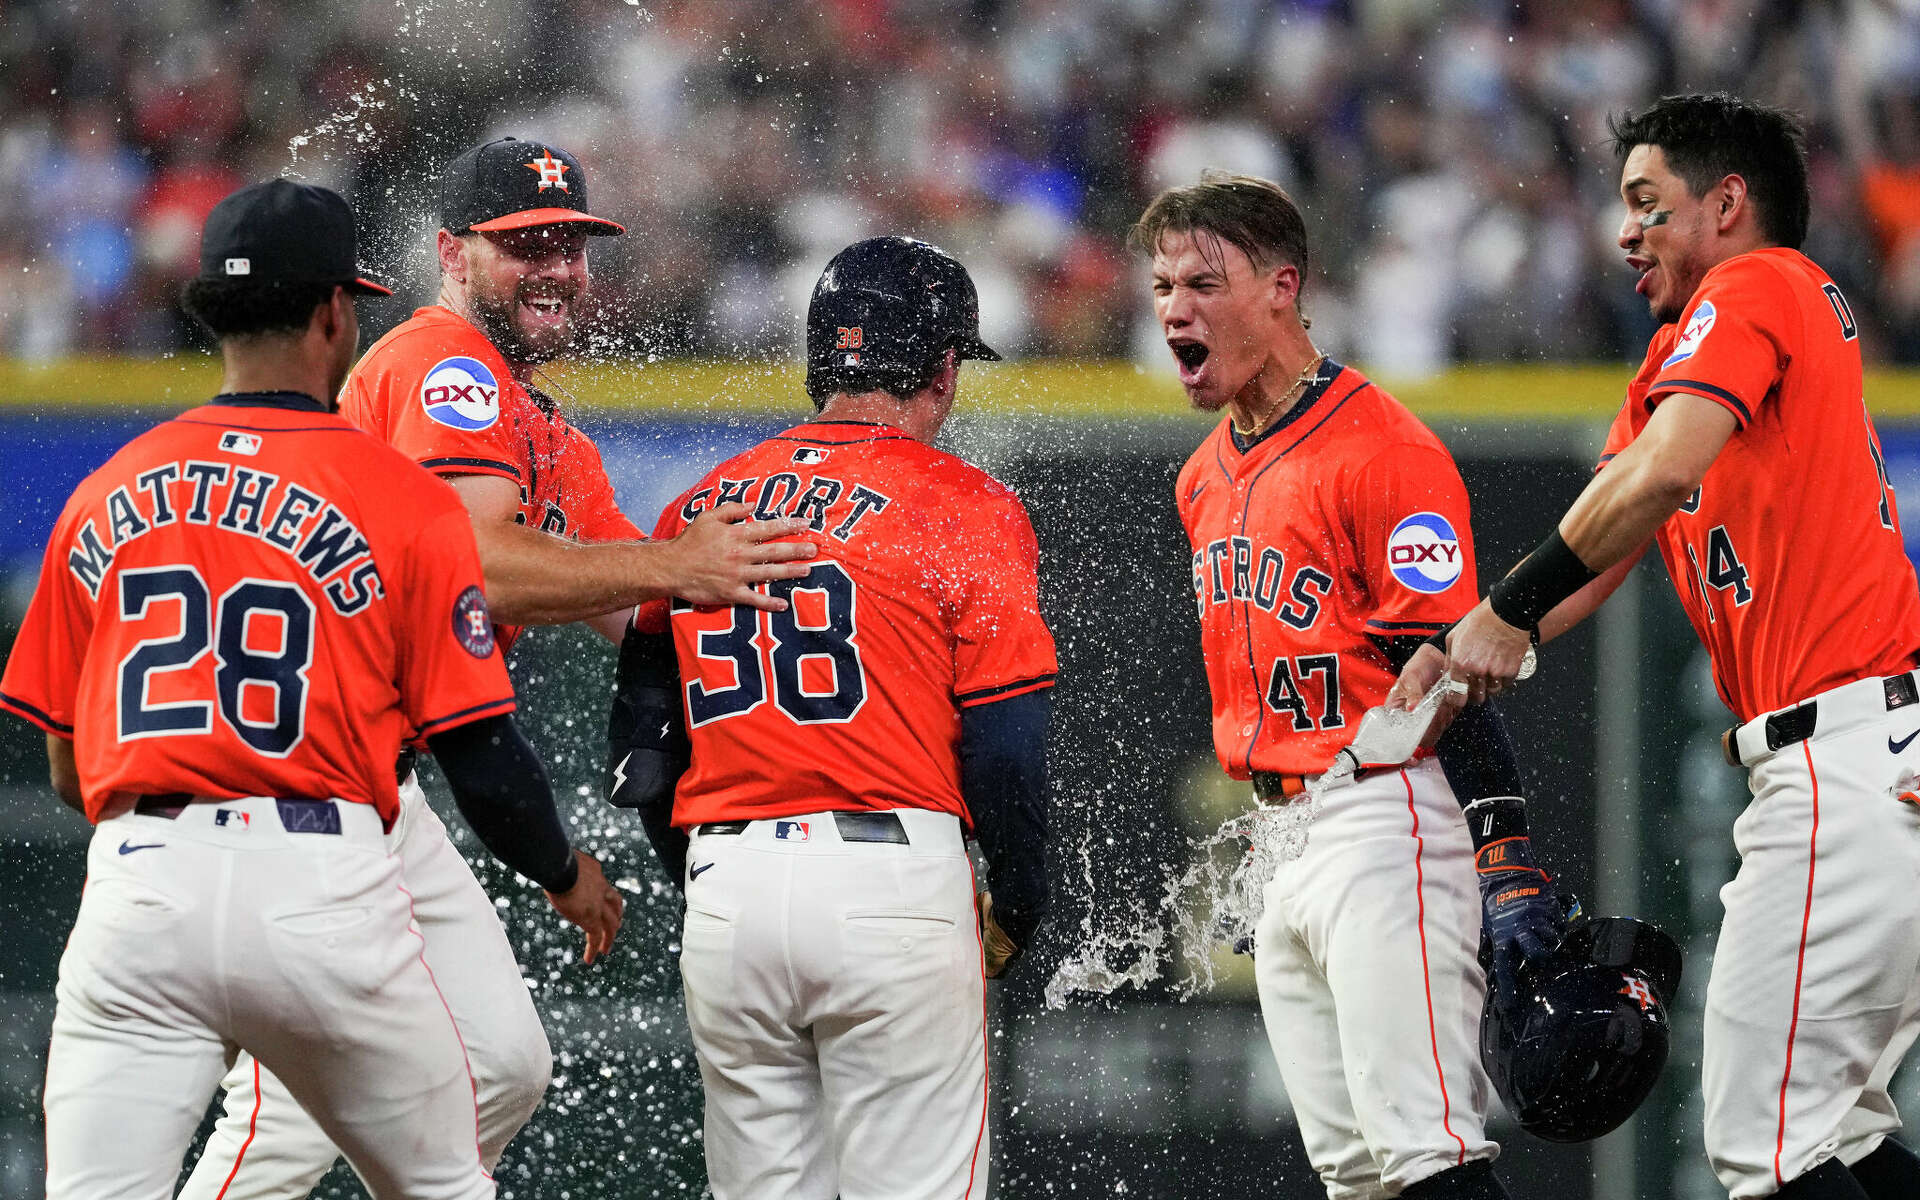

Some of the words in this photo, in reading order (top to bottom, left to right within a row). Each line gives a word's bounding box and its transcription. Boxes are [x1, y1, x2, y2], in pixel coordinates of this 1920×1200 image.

[533, 158, 568, 188] H
[836, 326, 863, 349] 38
[1680, 317, 1713, 343] XY
[425, 385, 497, 406] OXY
[681, 472, 892, 543] SHORT
[68, 461, 386, 616] MATTHEWS
[1391, 543, 1458, 564] OXY
[468, 610, 486, 635] H
[670, 560, 868, 730] 38
[118, 565, 317, 758] 28
[1265, 653, 1346, 733] 47
[1496, 887, 1539, 907] marucci
[1622, 976, 1655, 1006] H
